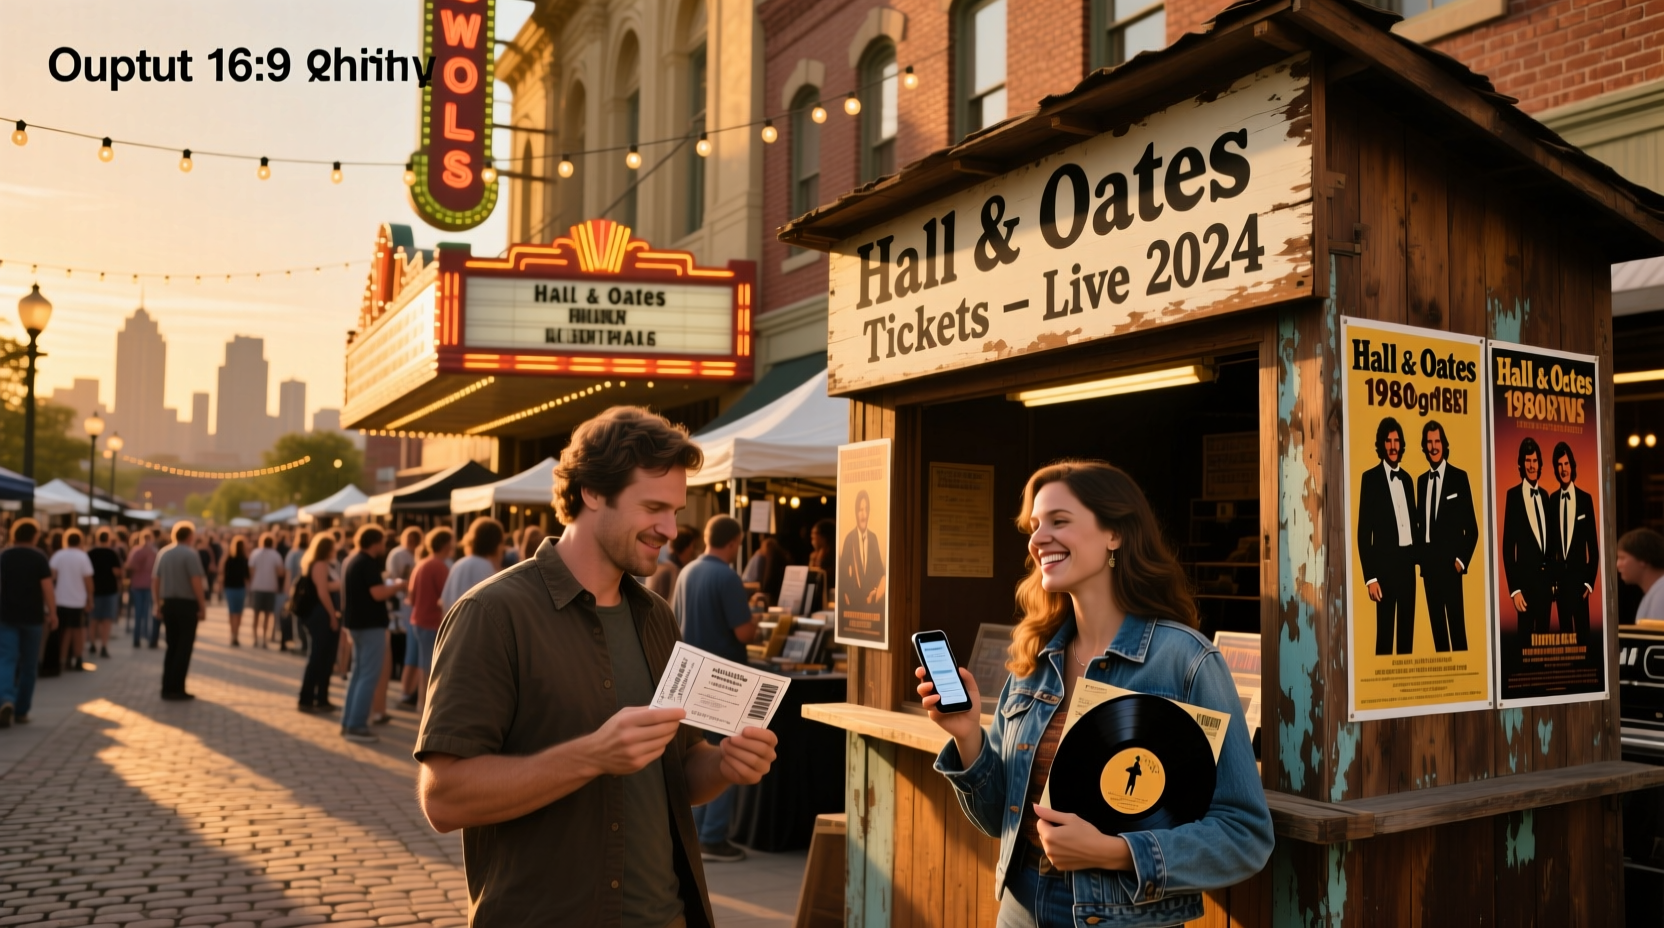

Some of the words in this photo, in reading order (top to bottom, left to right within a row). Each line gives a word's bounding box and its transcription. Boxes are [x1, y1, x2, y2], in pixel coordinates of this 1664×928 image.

[440, 0, 481, 189] WOLS
[856, 209, 957, 310] Hall
[974, 194, 1021, 272] &
[1039, 127, 1251, 250] Oates
[586, 286, 599, 306] &
[607, 287, 667, 308] Oates
[863, 298, 989, 363] Tickets
[1043, 263, 1130, 321] Live
[1146, 213, 1265, 296] 2024
[1352, 338, 1397, 374] Hall
[1400, 349, 1417, 376] &
[1420, 347, 1477, 383] Oates
[1496, 356, 1534, 388] Hall
[1536, 366, 1549, 390] &
